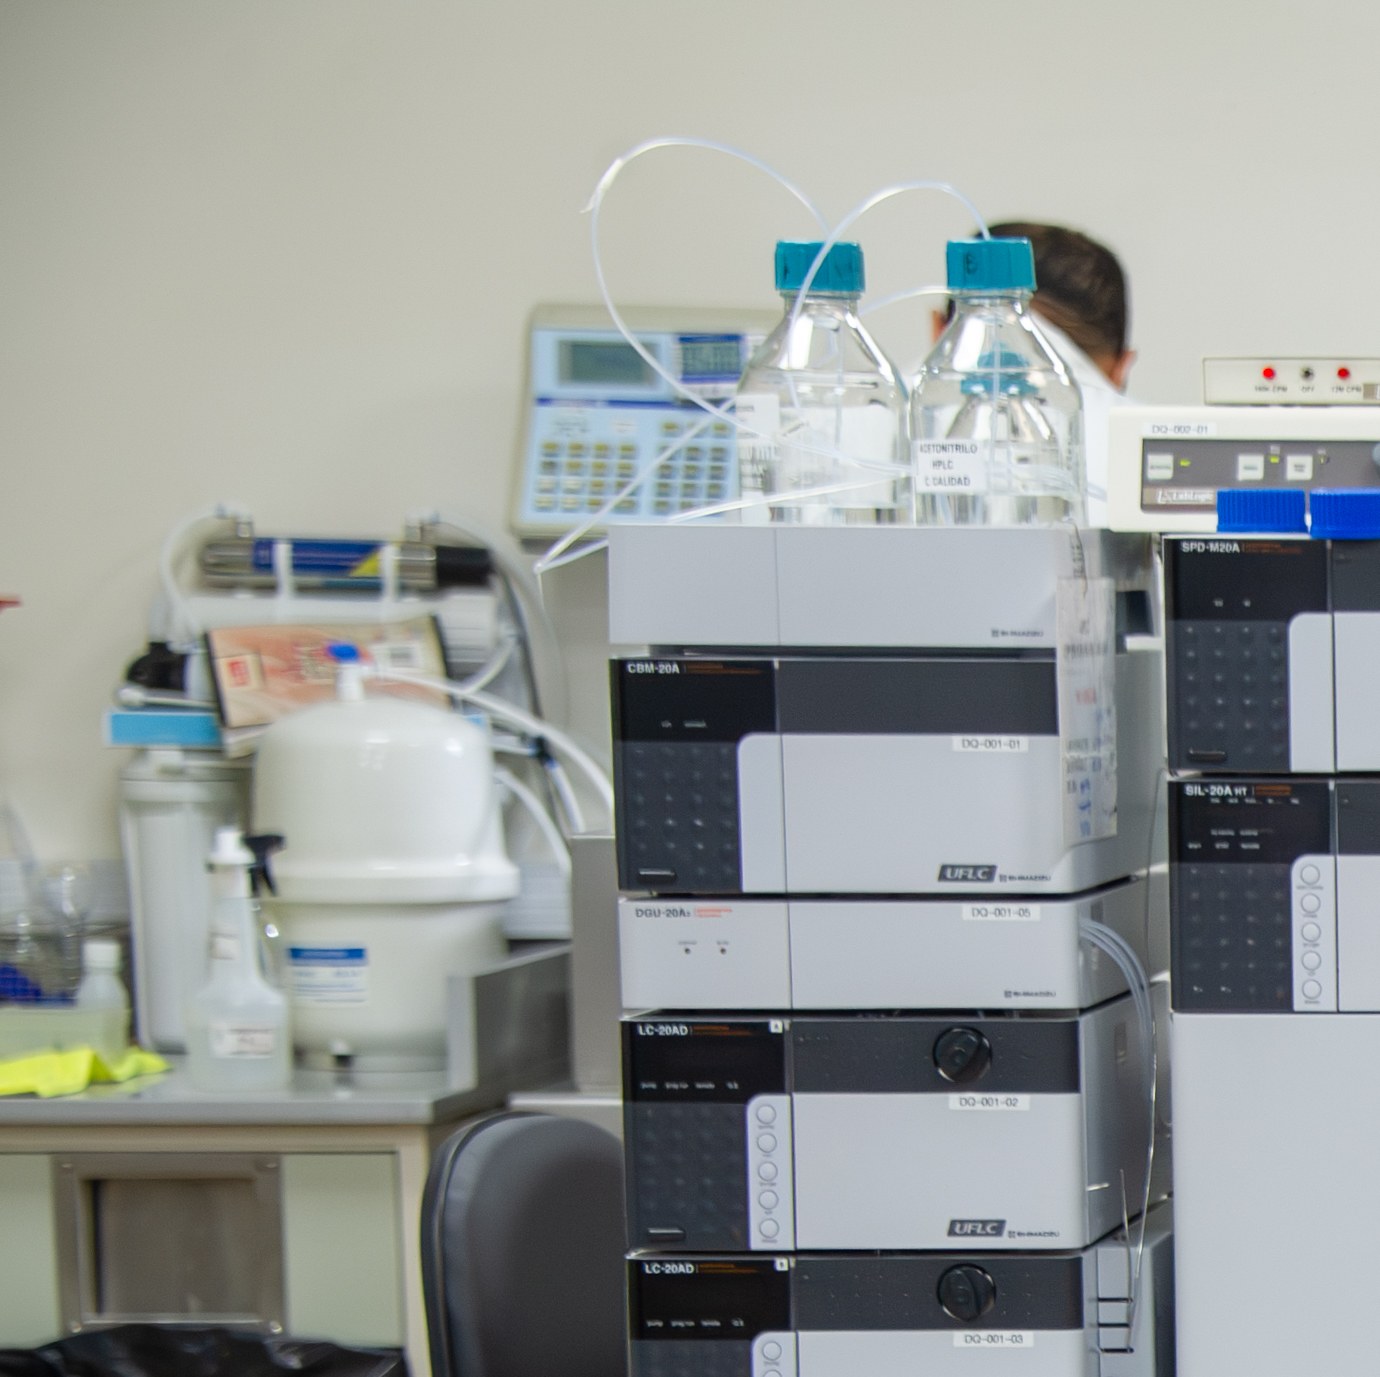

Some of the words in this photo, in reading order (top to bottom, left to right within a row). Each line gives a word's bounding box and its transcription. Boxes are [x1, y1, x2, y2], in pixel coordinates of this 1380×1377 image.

[1151, 424, 1209, 435] DQ-002-01
[920, 443, 978, 454] ACETONITRILO
[1181, 541, 1240, 553] SPD-M20A
[627, 662, 680, 674] CBM-20A
[961, 738, 1021, 749] DQ-001-01
[1185, 785, 1233, 796] SIL-20A
[945, 867, 989, 880] UFLC
[971, 907, 1031, 918] DQ-001-05
[638, 1024, 688, 1036] LC-20AD
[958, 1096, 1019, 1109] DQ-001-02
[954, 1222, 998, 1235] UFLC
[644, 1262, 695, 1275] LC-20AD
[964, 1334, 1024, 1344] DQ-001-03
